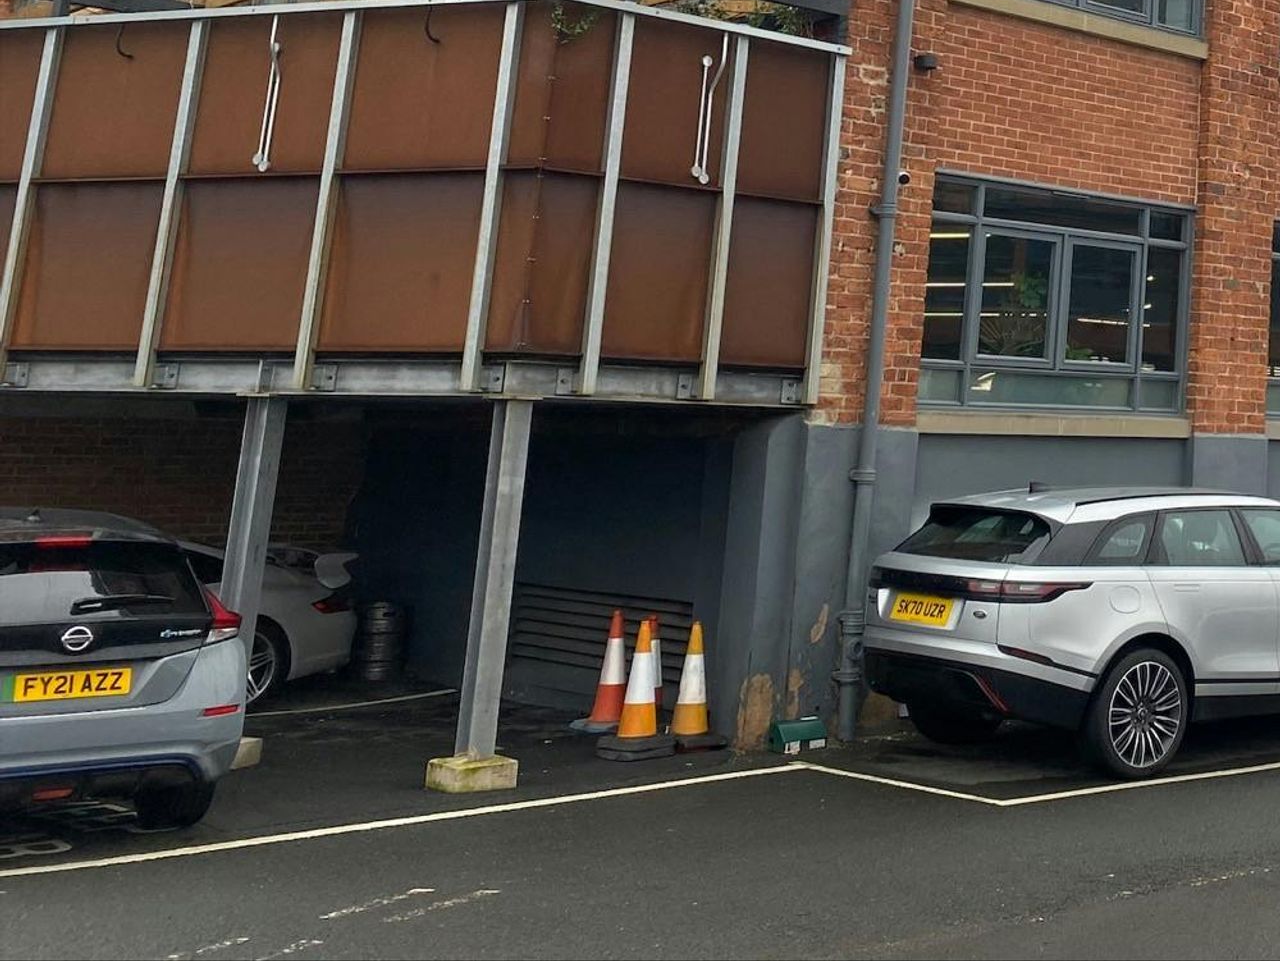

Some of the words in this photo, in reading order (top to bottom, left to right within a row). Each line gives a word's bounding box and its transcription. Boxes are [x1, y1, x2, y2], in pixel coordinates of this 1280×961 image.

[897, 599, 923, 615] SK70
[924, 601, 945, 618] UZR
[24, 675, 74, 697] FY21
[80, 671, 124, 691] AZZ
